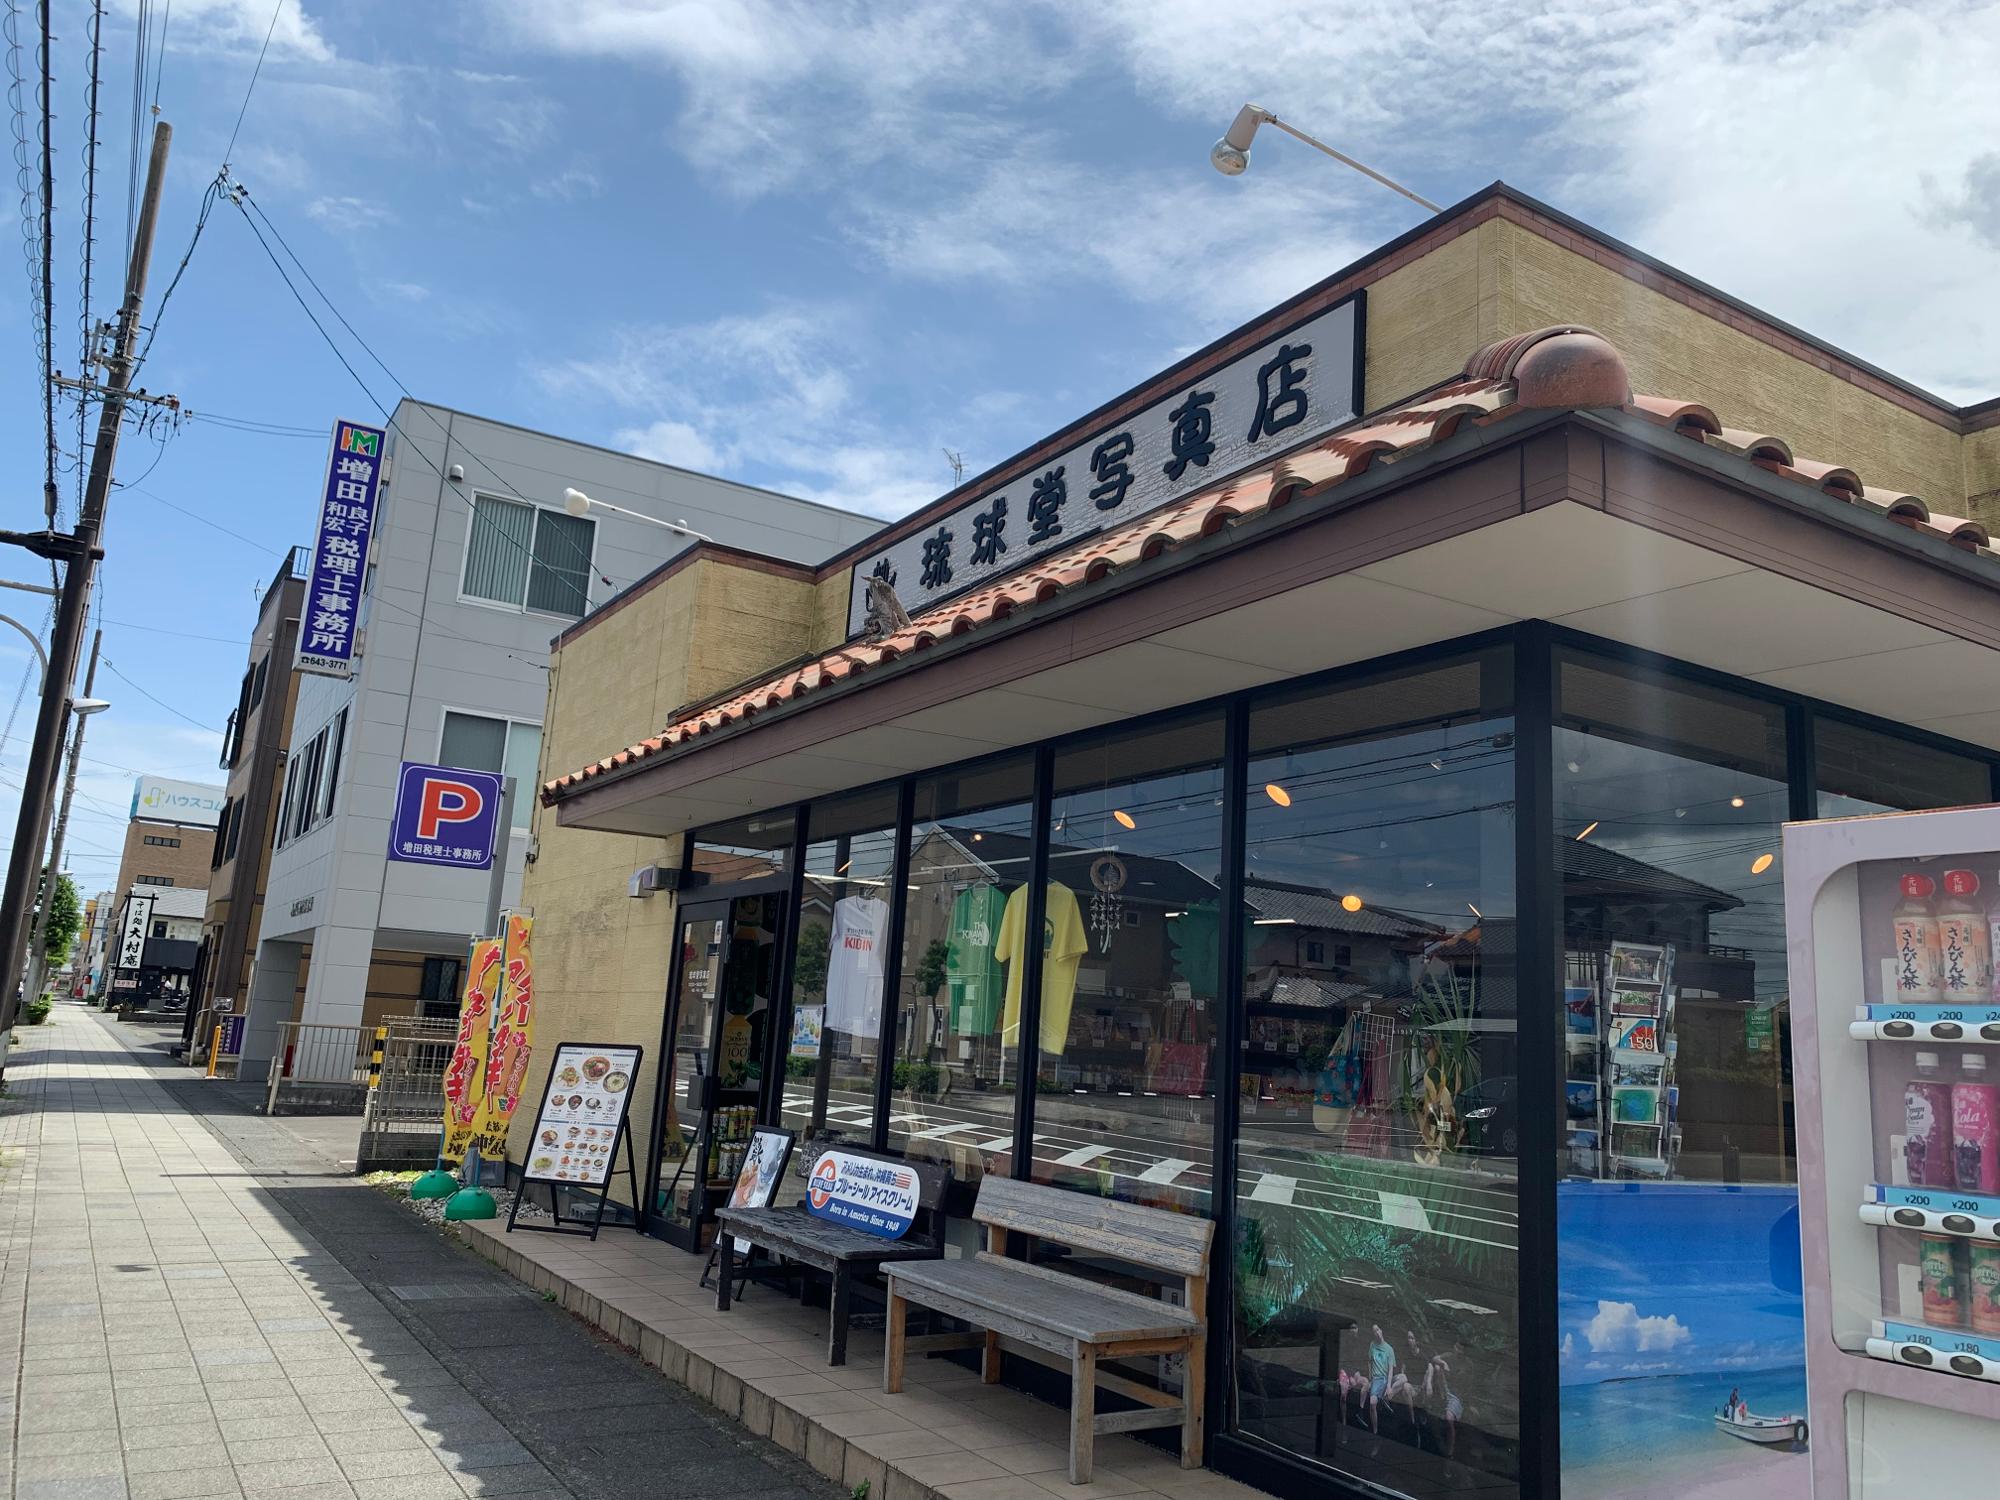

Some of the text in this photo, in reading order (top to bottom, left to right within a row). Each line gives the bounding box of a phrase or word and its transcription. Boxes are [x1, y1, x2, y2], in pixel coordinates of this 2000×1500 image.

[336, 457, 373, 503] 増田
[866, 343, 1312, 612] 琉球堂写真店
[324, 501, 347, 533] 和宏
[347, 506, 368, 535] 良子
[308, 536, 361, 653] 税理士事務所
[416, 777, 484, 840] P
[402, 841, 482, 861] 増田税理士事務所
[1890, 1011, 1916, 1020] ¥200
[1937, 1011, 1963, 1021] ¥200
[1905, 1195, 1930, 1206] ¥200
[1952, 1201, 1978, 1212] ¥200
[829, 1203, 900, 1231] Born in America Since 1948
[1906, 1335, 1932, 1346] ¥180
